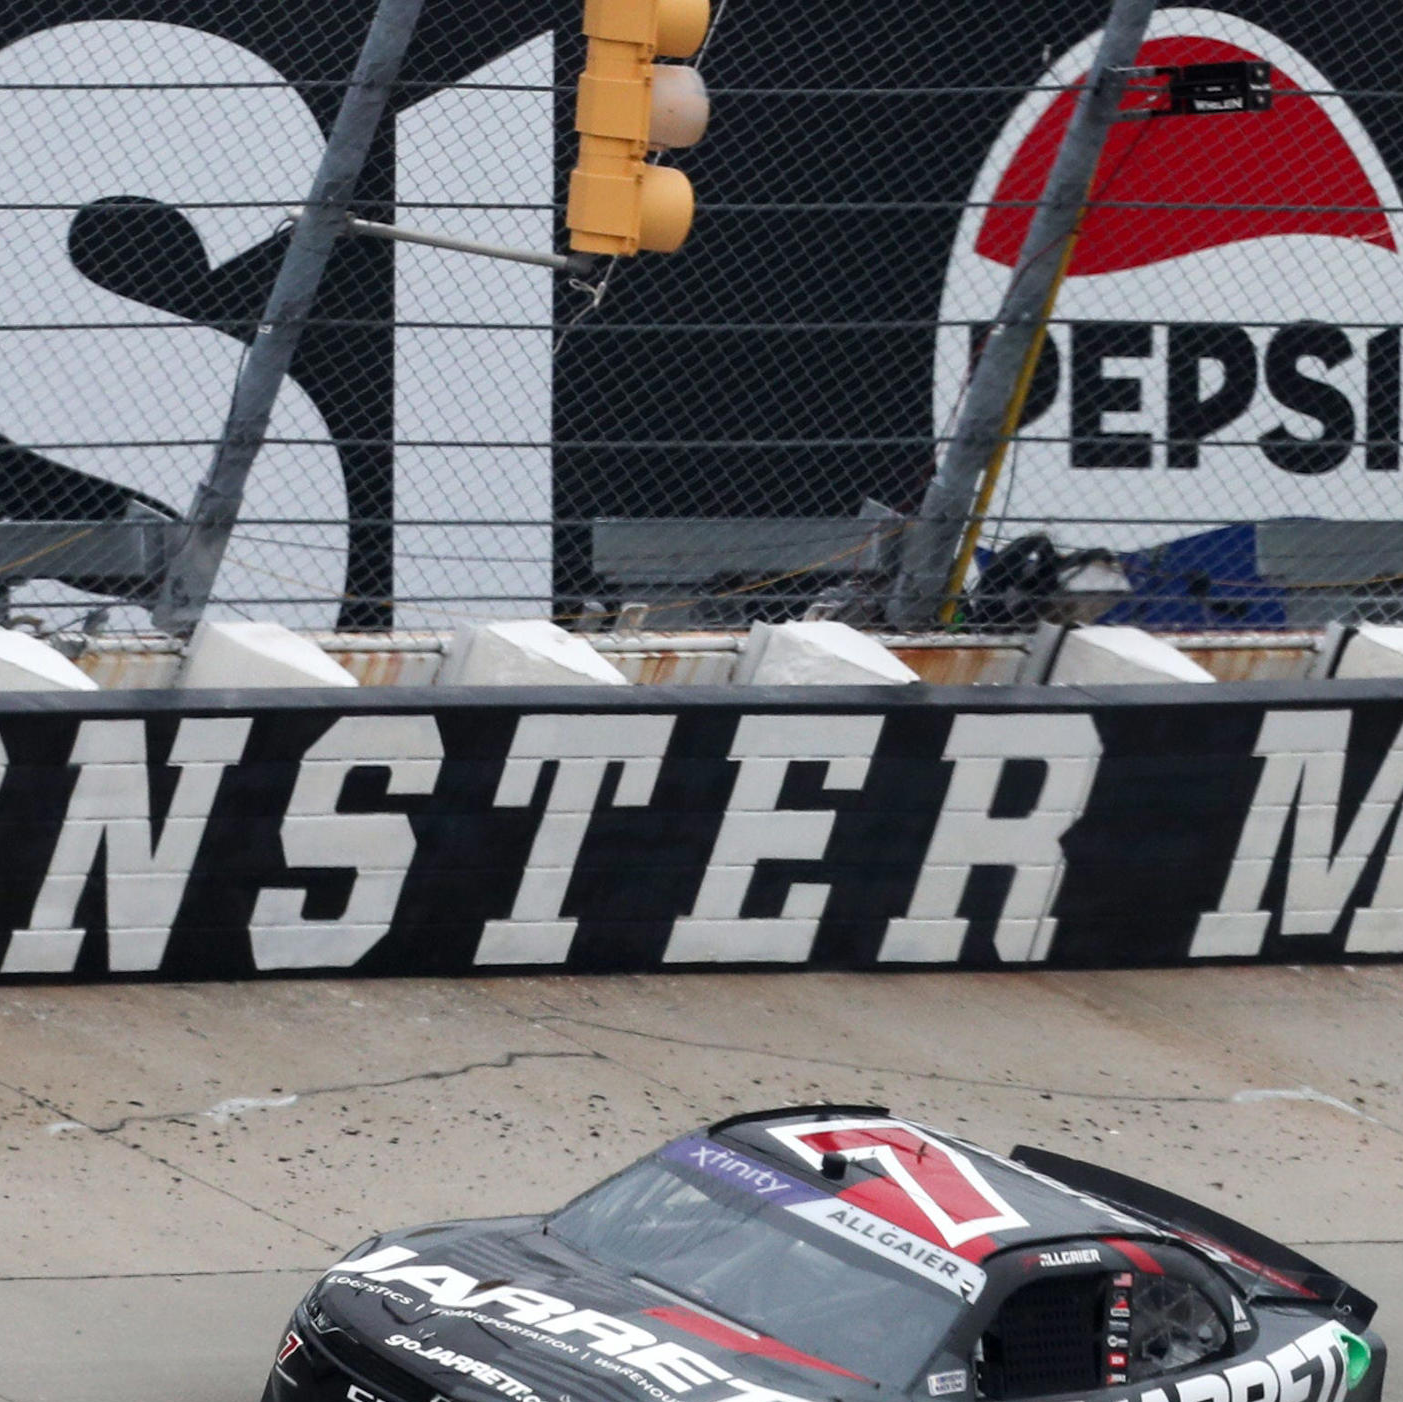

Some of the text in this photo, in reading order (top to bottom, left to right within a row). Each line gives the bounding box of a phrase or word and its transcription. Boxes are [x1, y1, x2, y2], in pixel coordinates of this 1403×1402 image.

[690, 1145, 791, 1194] xfinity
[765, 1117, 1028, 1248] 7
[826, 1209, 959, 1279] ALLGAIER
[277, 1330, 304, 1365] 7
[327, 1274, 413, 1305] LOGISTICS
[430, 1307, 580, 1354] TRANSPORTATION
